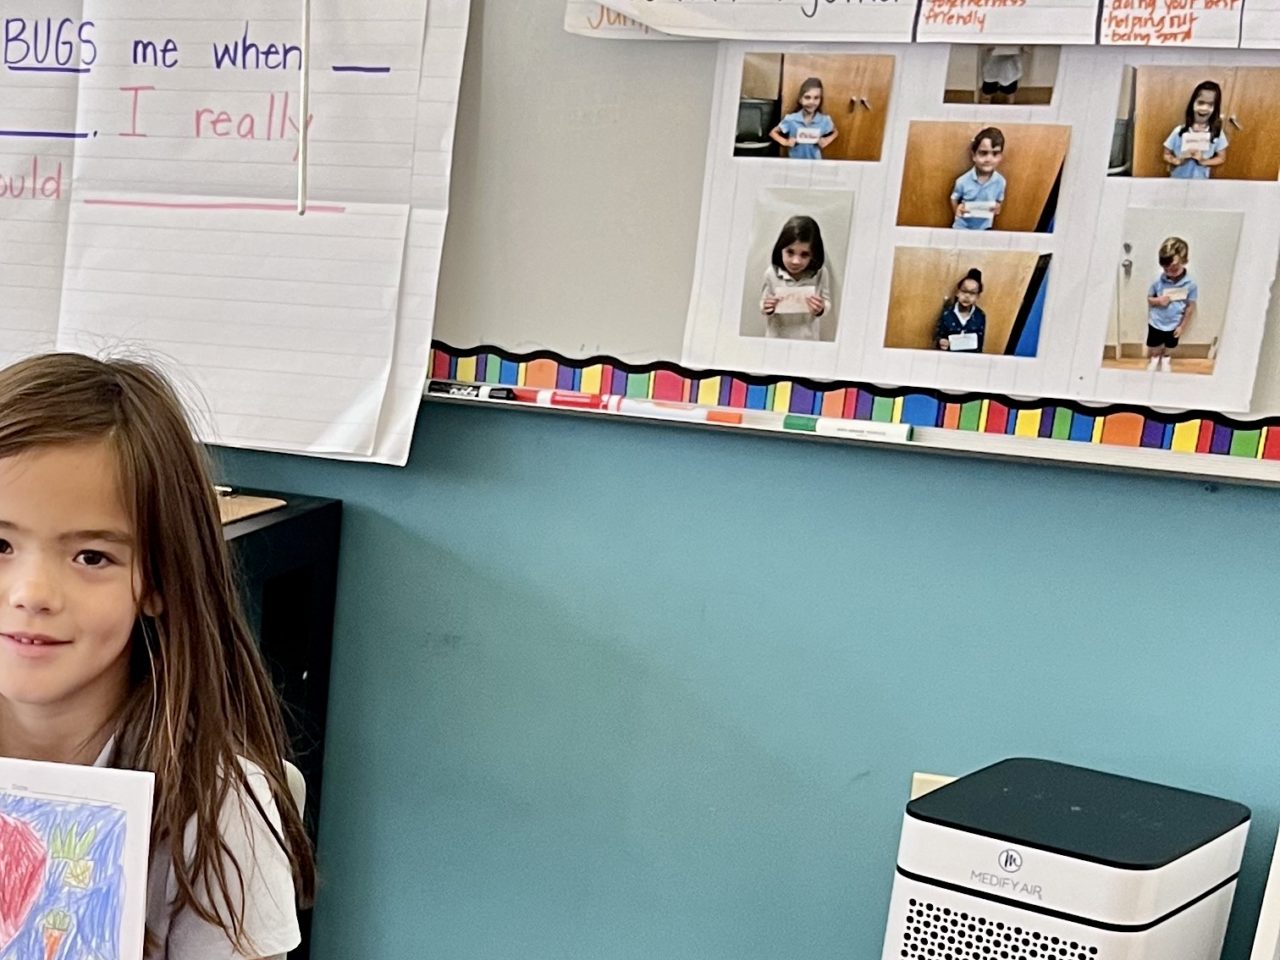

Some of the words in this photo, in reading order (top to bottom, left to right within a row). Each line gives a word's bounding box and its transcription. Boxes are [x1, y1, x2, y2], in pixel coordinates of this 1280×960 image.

[924, 6, 987, 33] friendly
[4, 17, 97, 66] BUGS
[132, 38, 179, 69] me
[212, 20, 303, 72] when
[119, 85, 156, 138] I
[194, 91, 314, 163] really
[970, 870, 1020, 891] MEDIFY
[1020, 883, 1043, 900] AIR
